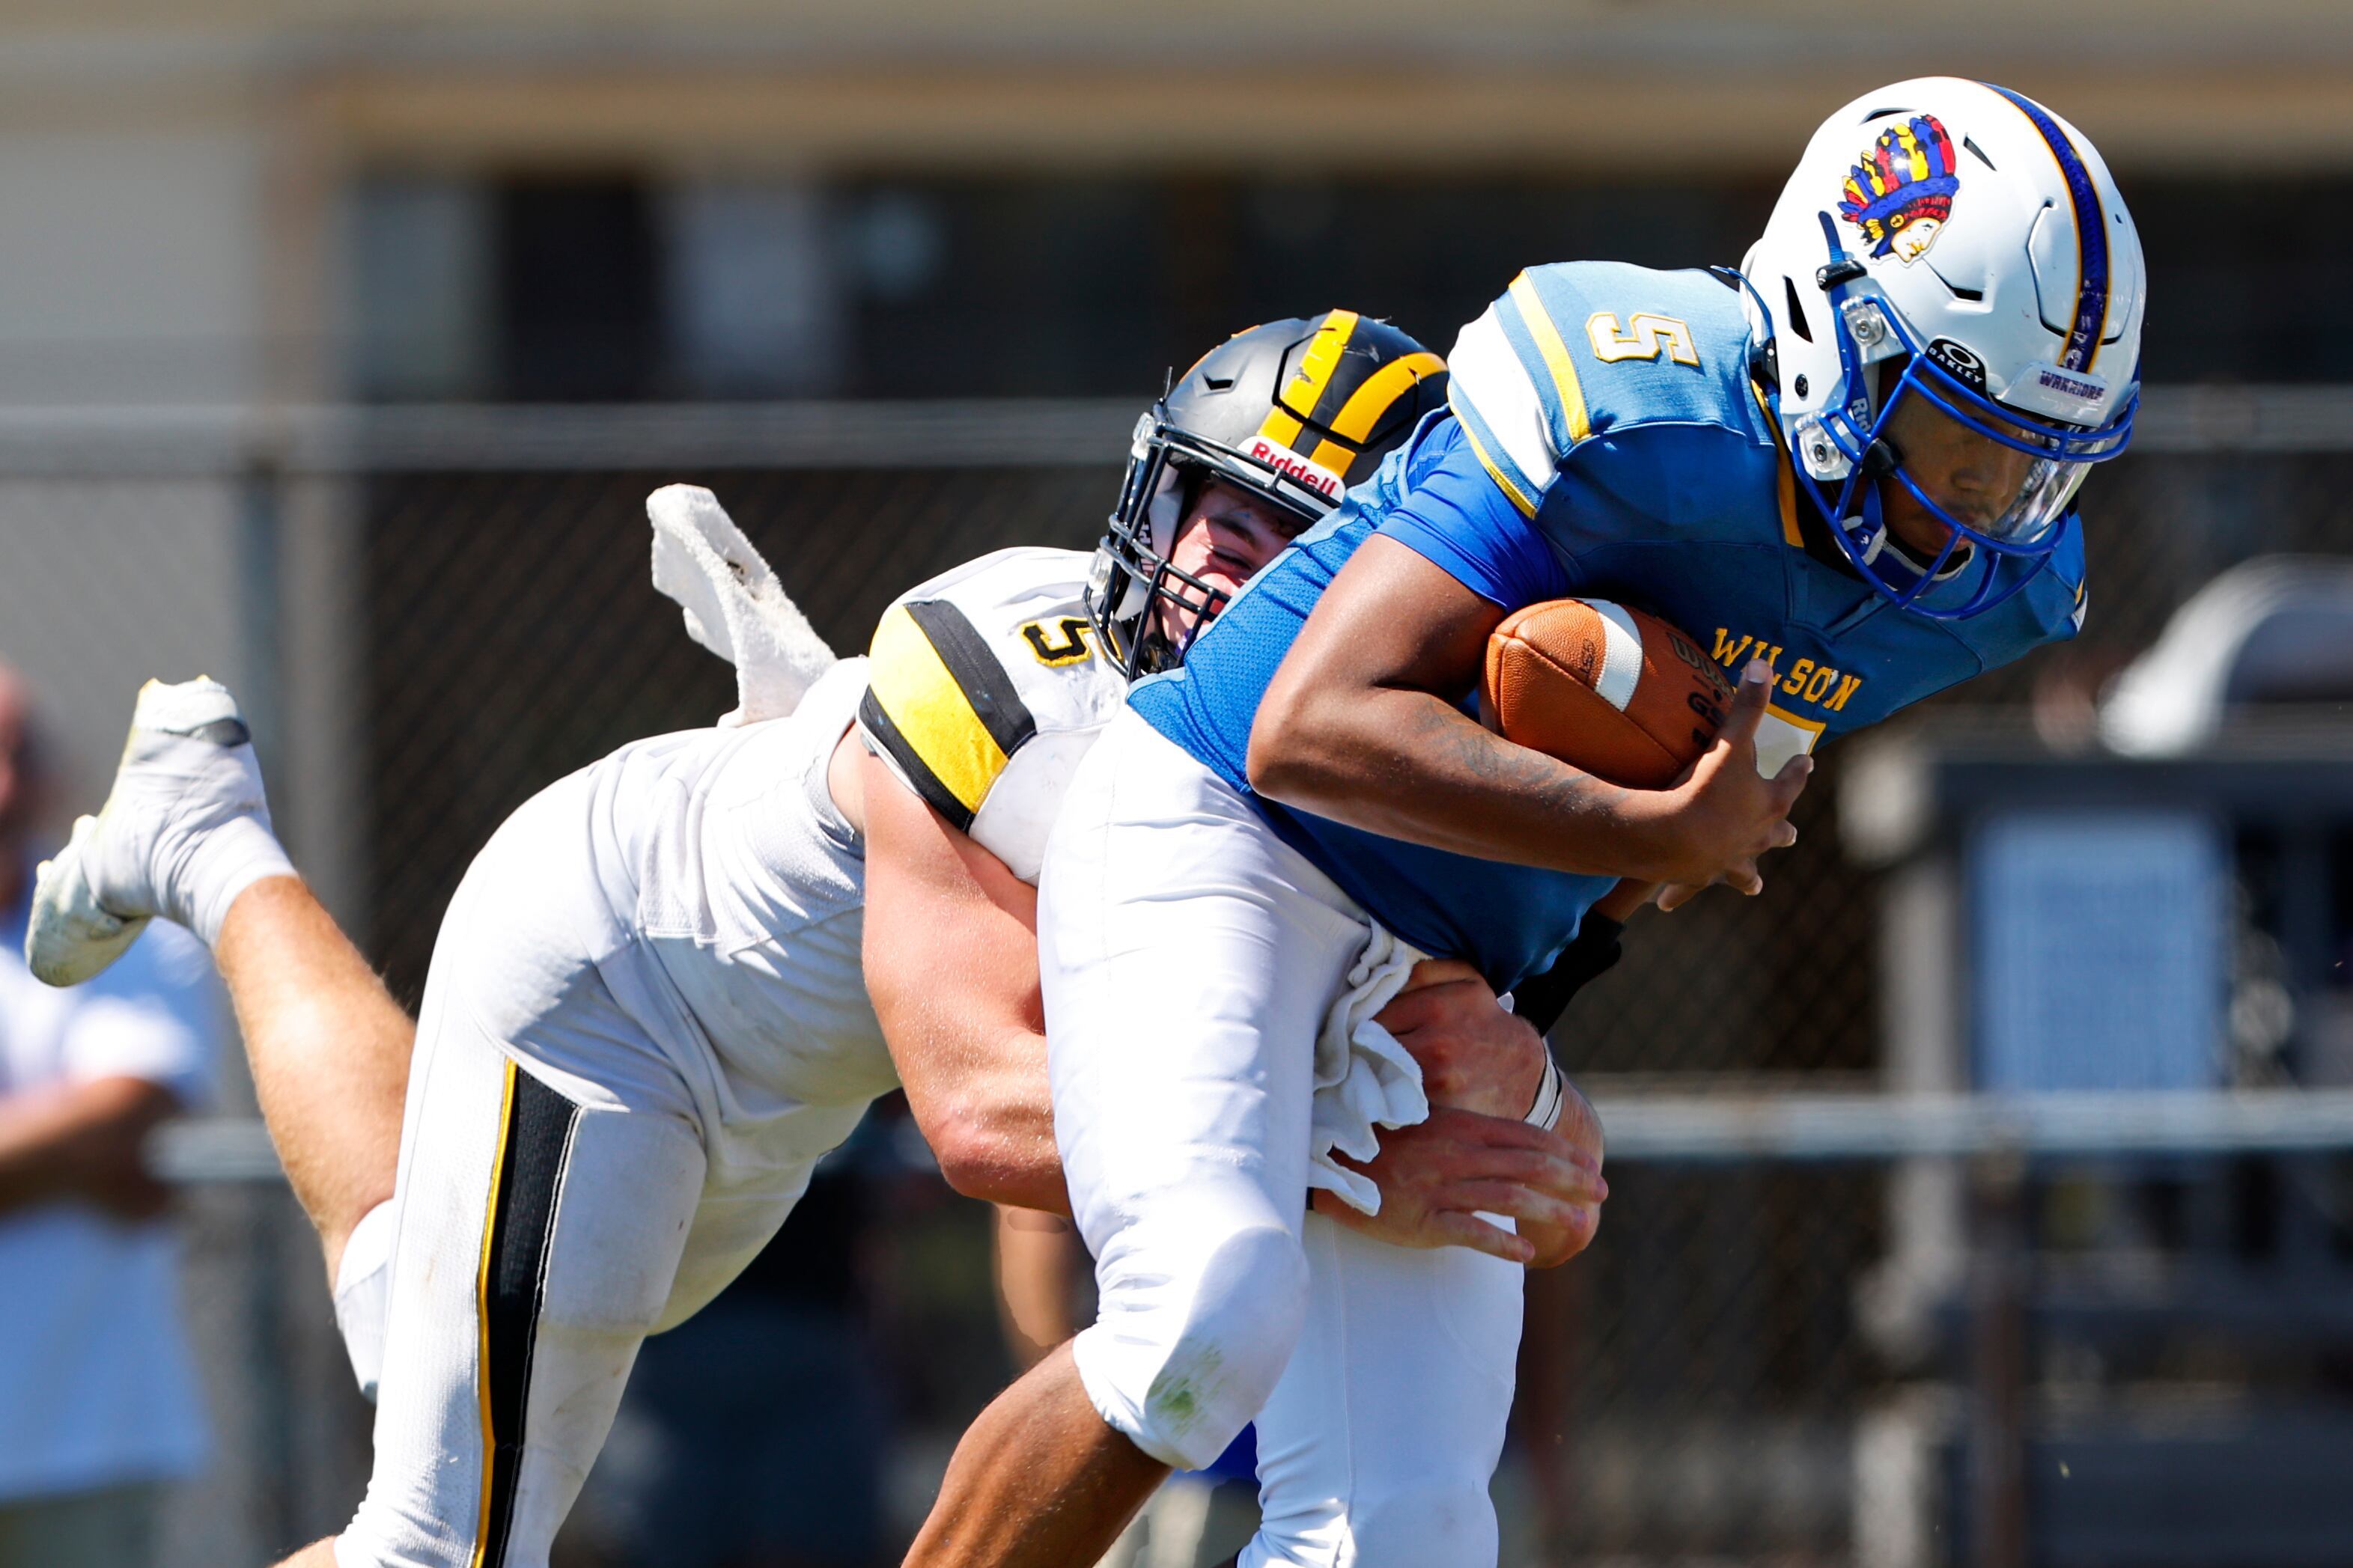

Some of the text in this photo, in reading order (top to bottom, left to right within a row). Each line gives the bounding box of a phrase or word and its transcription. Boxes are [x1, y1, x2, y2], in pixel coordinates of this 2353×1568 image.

[1585, 311, 1700, 367] 5
[1928, 347, 1983, 383] OAKLEY
[1251, 442, 1337, 495] Riddell
[1710, 627, 1862, 712] WILSON
